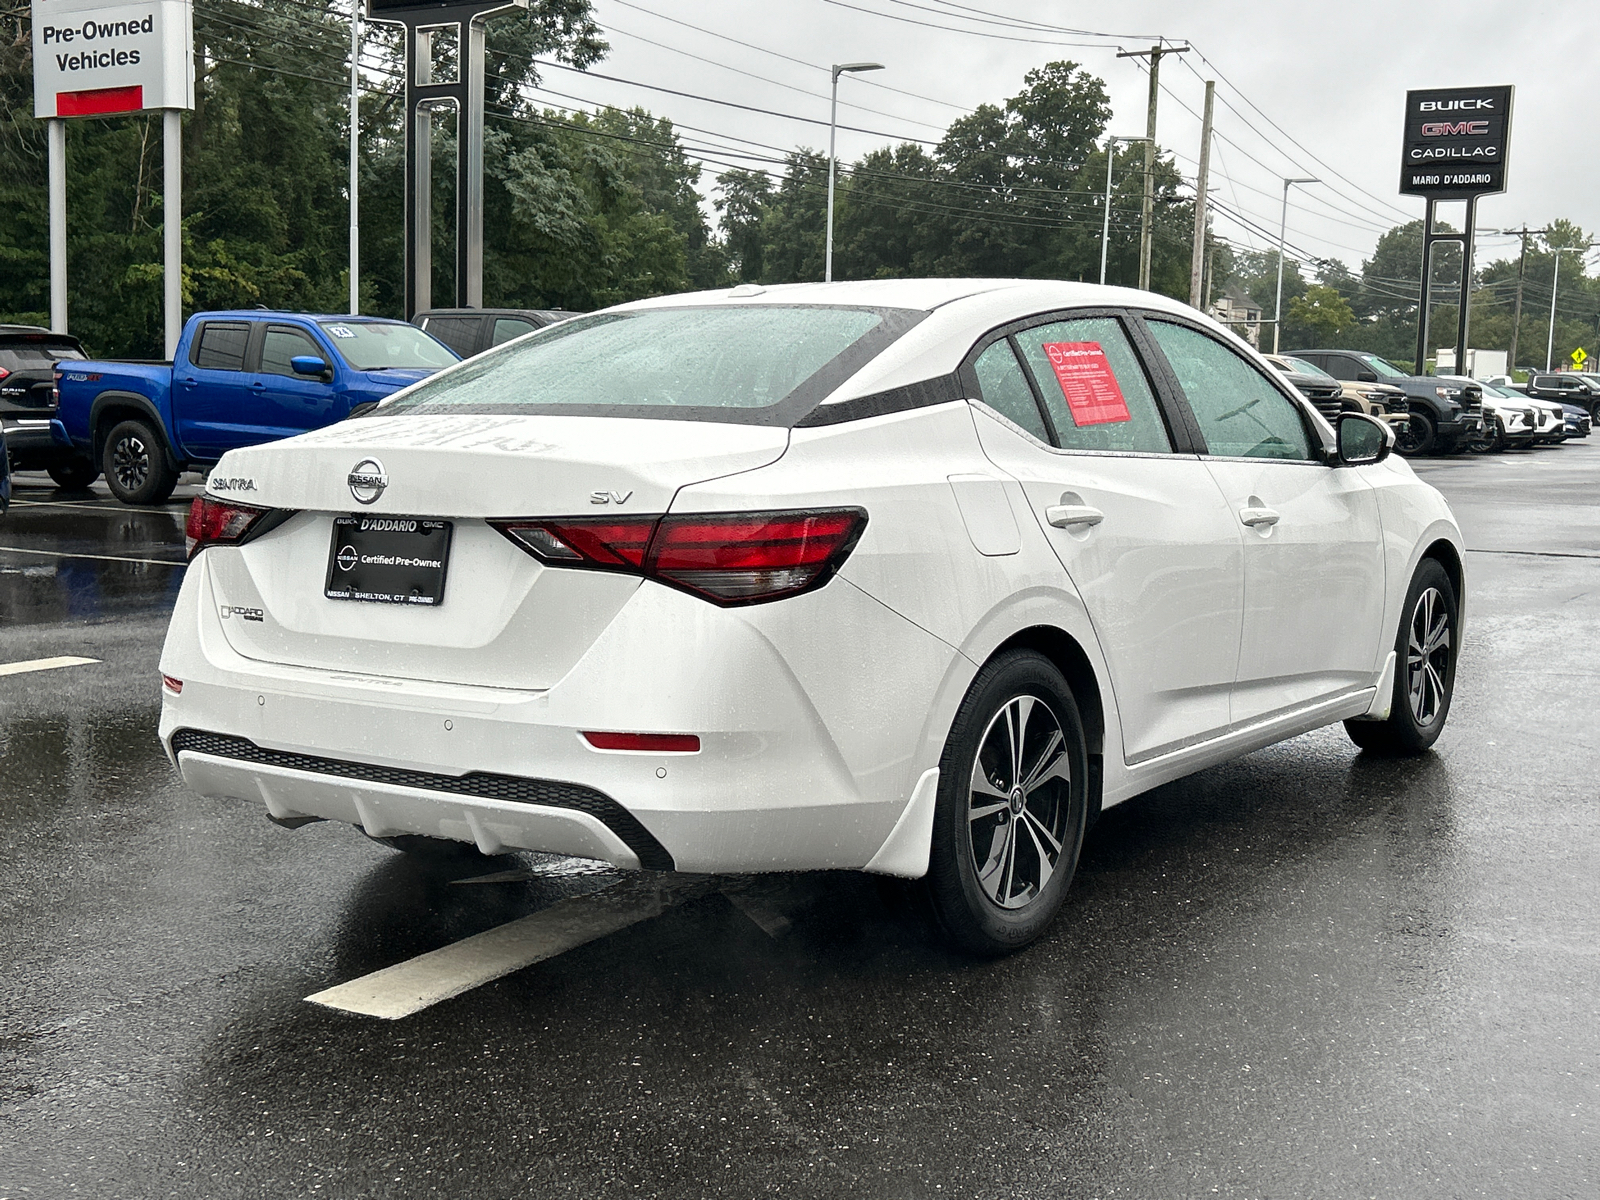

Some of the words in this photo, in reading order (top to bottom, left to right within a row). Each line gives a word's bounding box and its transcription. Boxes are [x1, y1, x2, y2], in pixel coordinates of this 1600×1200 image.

[43, 14, 153, 45] Pre-Owned
[56, 48, 141, 72] Vehicles
[1420, 99, 1494, 111] BUICK
[1422, 121, 1489, 136] GMC
[1411, 147, 1497, 158] CADILLAC
[1413, 175, 1440, 185] MARIO
[1444, 174, 1491, 185] D'ADDARIO
[212, 478, 258, 491] SENTRA
[590, 490, 633, 504] SV
[360, 519, 417, 532] D'ADDARIO
[422, 521, 444, 529] GMC
[361, 554, 395, 565] Certified
[327, 590, 350, 598] NISSAN
[355, 592, 392, 601] SHELTON,
